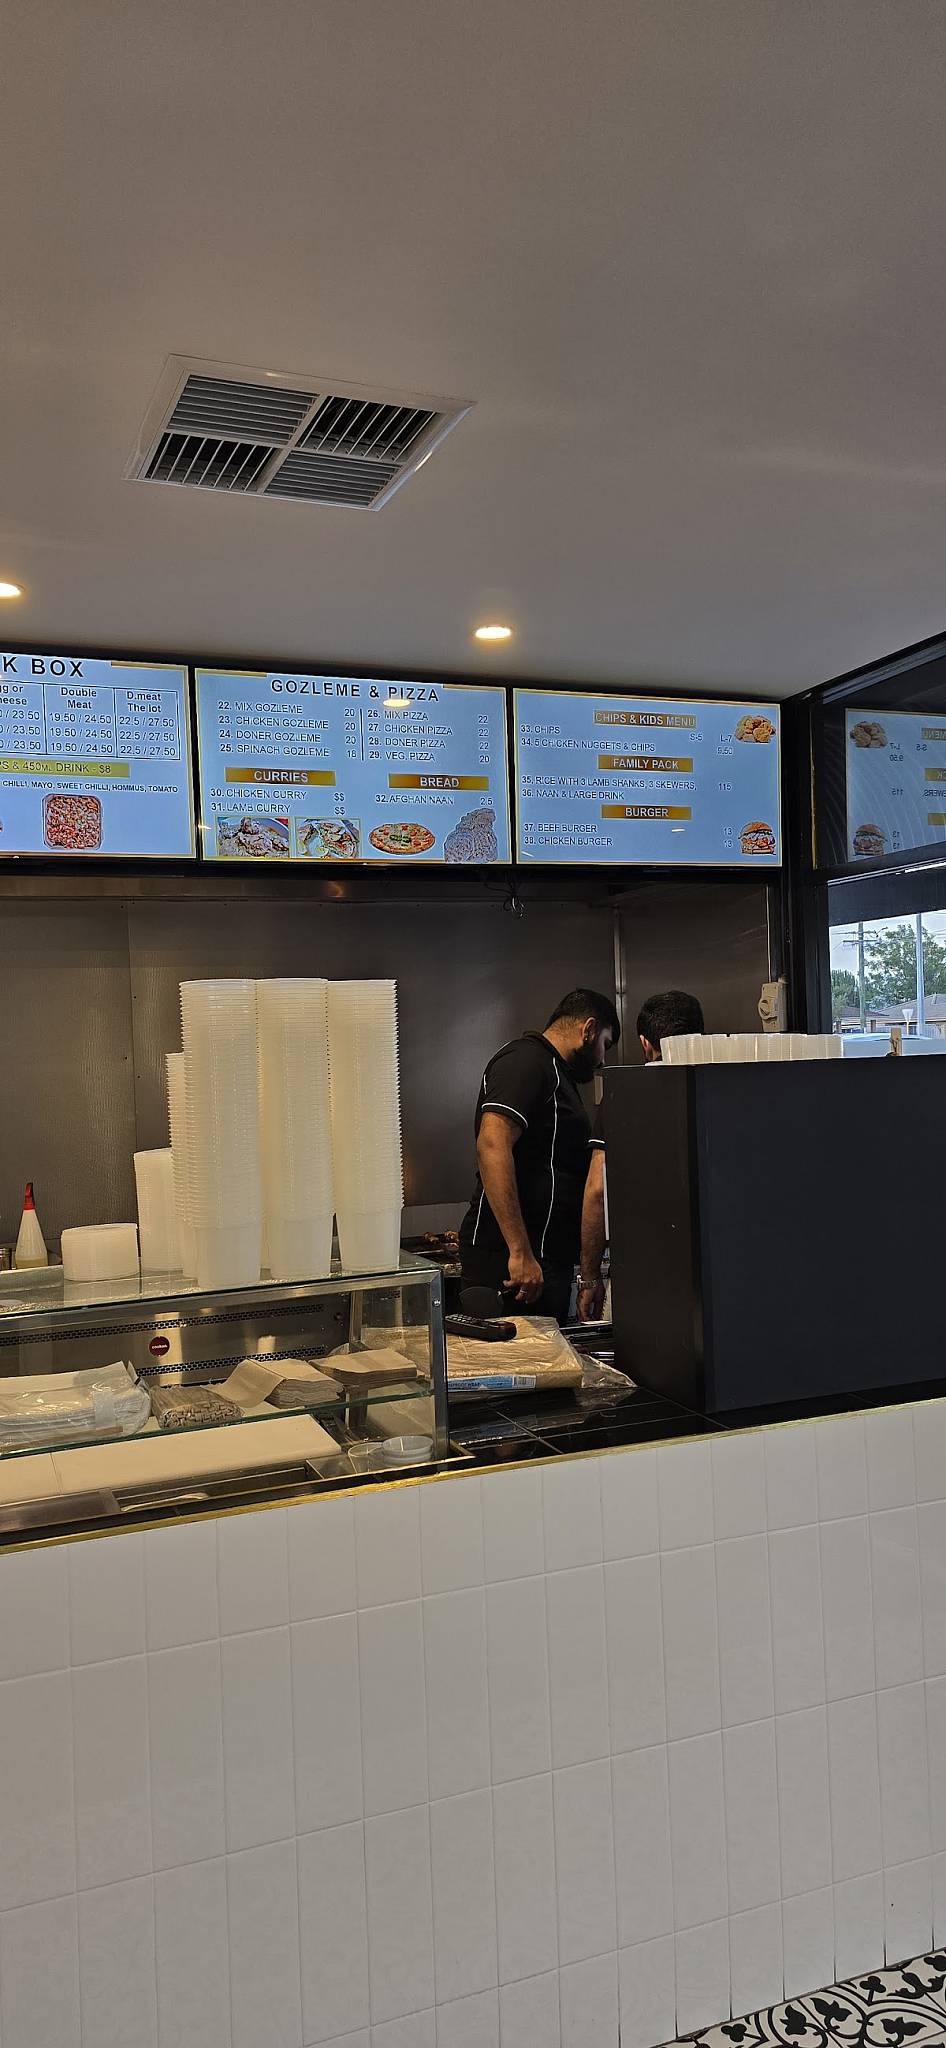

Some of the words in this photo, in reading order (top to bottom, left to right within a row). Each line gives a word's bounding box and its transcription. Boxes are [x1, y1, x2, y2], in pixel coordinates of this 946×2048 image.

[32, 658, 83, 677] BOX
[61, 687, 97, 697] Double
[271, 680, 360, 697] GOZLEME
[369, 686, 379, 698] &
[388, 687, 439, 701] PIZZA
[127, 691, 161, 701] D.meat
[67, 700, 92, 709] Meat
[127, 703, 146, 712] The
[149, 704, 161, 712] lot
[218, 702, 232, 710] 22.
[236, 702, 252, 711] MIX
[256, 704, 302, 714] GOZLEME
[12, 710, 40, 720] 23.50
[50, 712, 76, 722] 19.50
[85, 715, 112, 724] 24.50
[368, 710, 380, 718] 26.
[384, 711, 400, 719] MIX
[403, 712, 428, 720] PIZZA
[596, 712, 626, 723] CHIPS
[630, 714, 637, 724] &
[640, 714, 663, 725] KIDS
[666, 716, 695, 726] MENU
[120, 716, 140, 725] 22.5
[148, 718, 174, 727] 27.50
[219, 716, 232, 724] 23.
[236, 717, 280, 726] CHICKEN
[282, 719, 328, 729] GOZLEME
[13, 726, 40, 735] 23.50
[50, 728, 76, 737] 19.50
[86, 729, 112, 738] 24.50
[368, 724, 380, 732] 27.
[384, 725, 425, 734] CHICKEN
[428, 726, 452, 735] PIZZA
[535, 726, 560, 734] CHIPS
[120, 731, 140, 740] 22.5
[149, 733, 174, 741] 27.50
[220, 730, 232, 738] 24.
[236, 731, 272, 740] DONER
[274, 733, 320, 742] GOZLEME
[346, 736, 356, 744] 20
[14, 741, 41, 750] 23.50
[369, 737, 382, 746] 28.
[386, 738, 418, 747] DONER
[420, 739, 446, 748] PIZZA
[542, 739, 578, 748] CHICKEN
[582, 741, 621, 750] NUGGETS
[632, 743, 656, 752] CHIPS
[51, 743, 76, 752] 19.50
[86, 744, 112, 753] 24.50
[120, 746, 140, 754] 22.5
[150, 747, 176, 756] 27.50
[220, 744, 234, 752] 25.
[237, 745, 280, 755] SPINACH
[284, 747, 330, 756] GOZLEME
[370, 751, 382, 759] 29.
[386, 752, 407, 760] VEG.
[410, 752, 436, 761] PIZZA
[56, 762, 89, 772] DRINK
[613, 759, 649, 769] FAMILY
[652, 760, 679, 770] PACK
[254, 771, 308, 782] CURRIES
[420, 777, 460, 788] BREAD
[522, 776, 534, 784] 35.
[536, 776, 556, 785] RICE
[558, 777, 578, 786] WITH
[580, 778, 586, 786] 3
[588, 779, 610, 787] LAMB
[656, 780, 697, 790] SKEWERS,
[210, 788, 224, 797] 30.
[226, 789, 270, 798] CHICKEN
[272, 791, 306, 800] CURRY
[569, 791, 596, 799] LARGE
[212, 802, 224, 811] 31.
[227, 803, 253, 812] LAMB
[256, 804, 290, 812] CURRY
[625, 808, 669, 817] BURGER
[524, 824, 536, 832] 37.
[562, 824, 597, 832] BURGER
[538, 837, 576, 846] CHICKEN
[578, 838, 612, 846] BURGER
